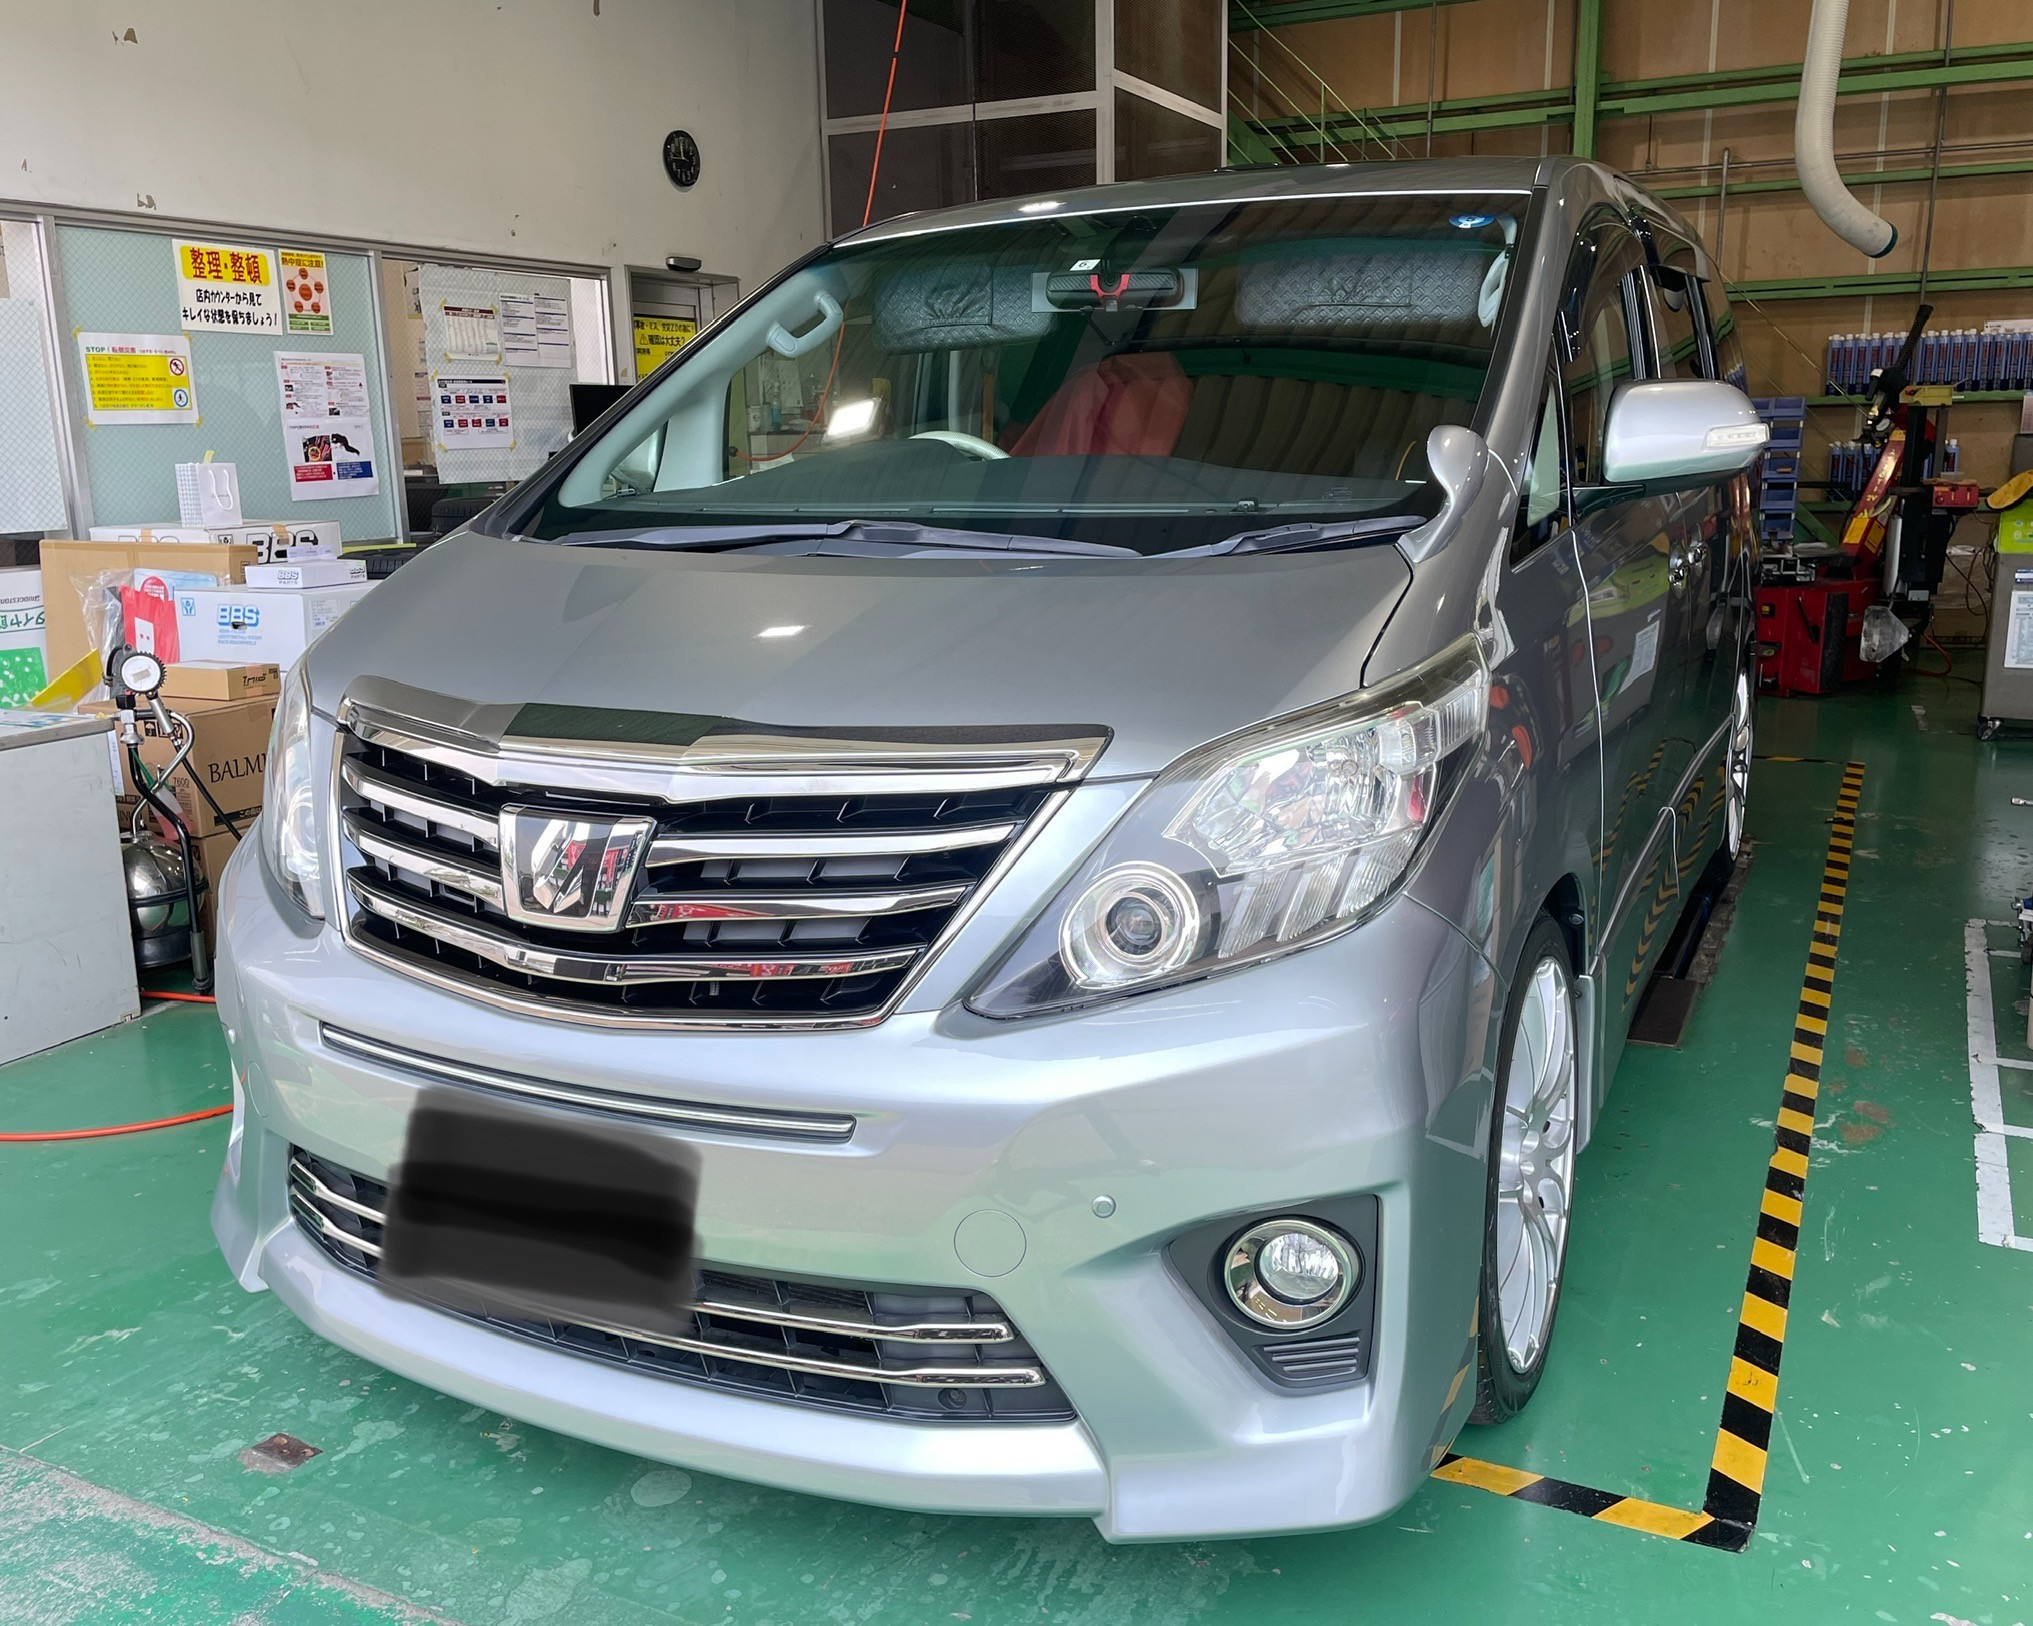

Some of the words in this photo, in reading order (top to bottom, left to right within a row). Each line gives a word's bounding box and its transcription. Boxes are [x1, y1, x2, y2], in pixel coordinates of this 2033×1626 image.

[190, 247, 263, 284] 整理・整頓
[195, 288, 263, 306] 店内カウンターから見て
[277, 569, 299, 581] BBS
[217, 603, 260, 627] BBS
